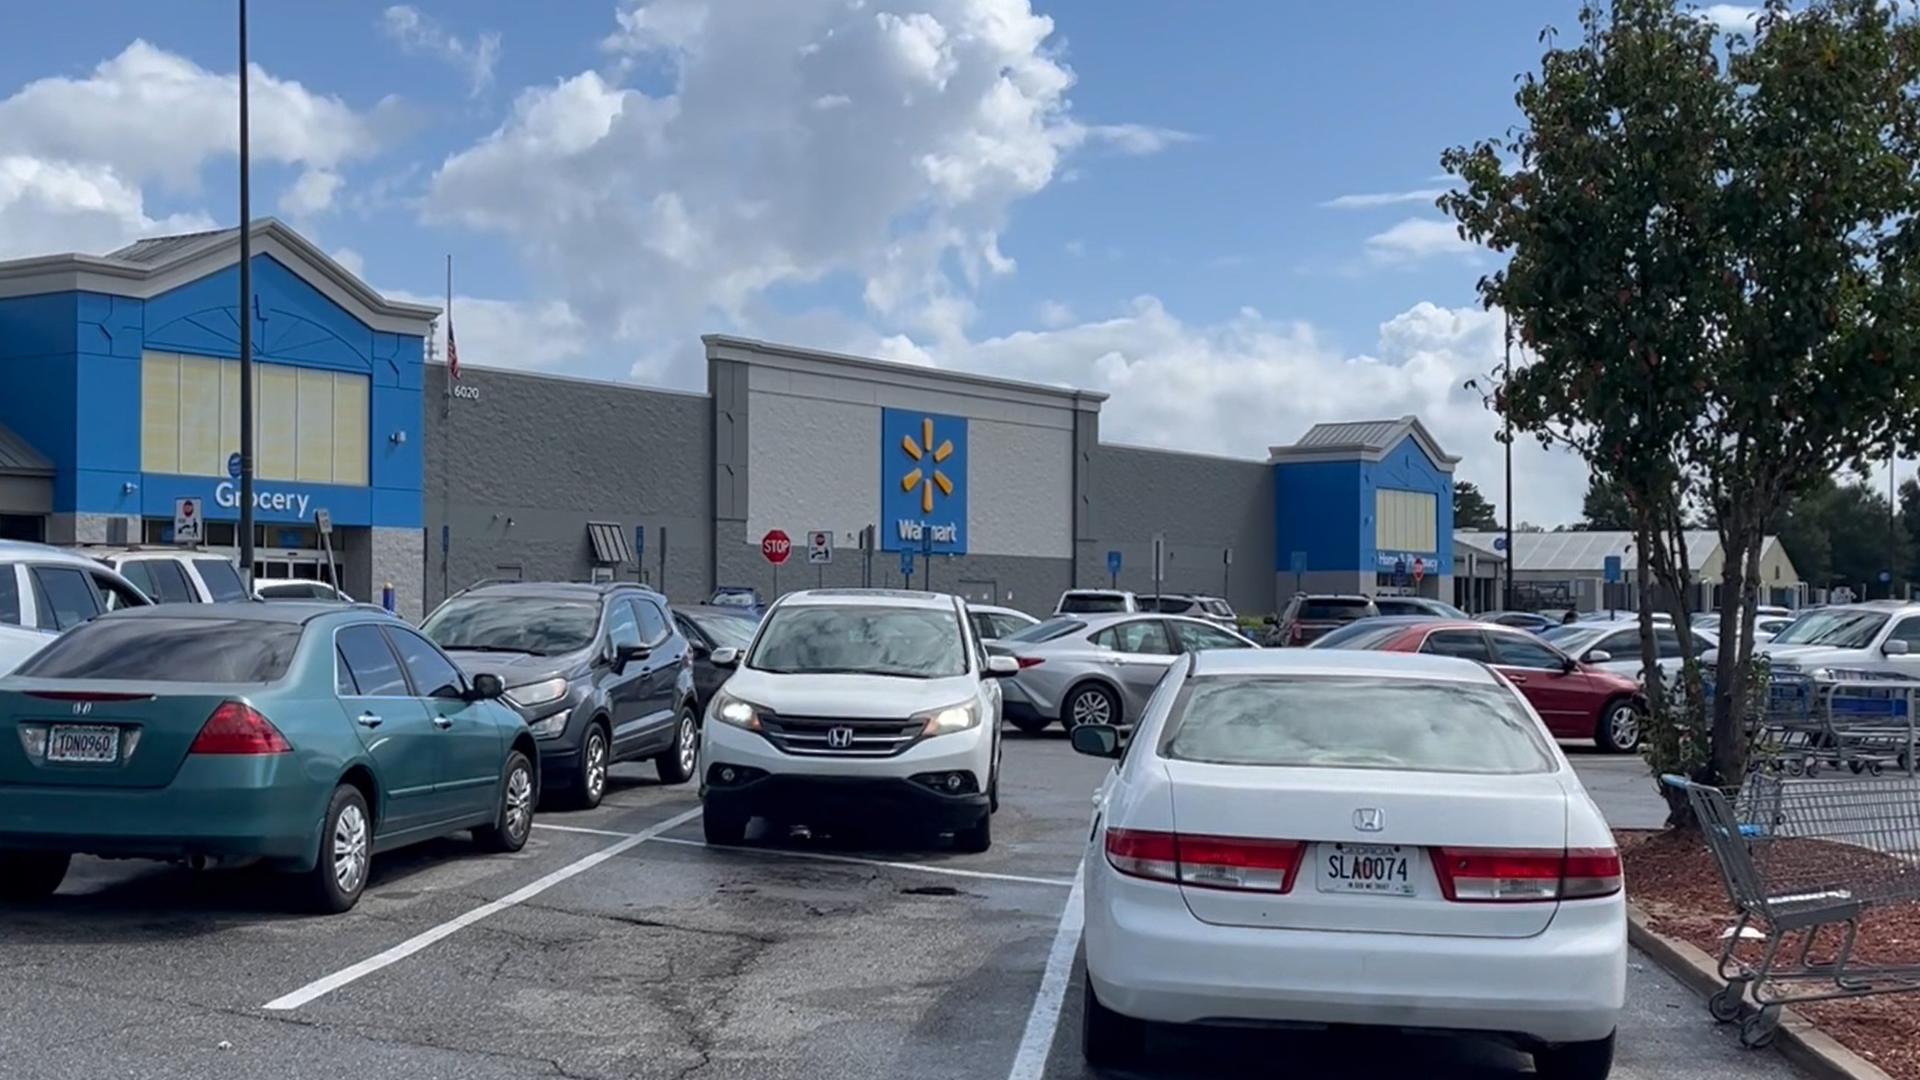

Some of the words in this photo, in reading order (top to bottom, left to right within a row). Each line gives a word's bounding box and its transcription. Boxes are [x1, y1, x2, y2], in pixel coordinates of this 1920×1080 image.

[454, 385, 479, 399] 6020
[764, 539, 789, 554] STOP
[1328, 855, 1408, 882] SLA0074
